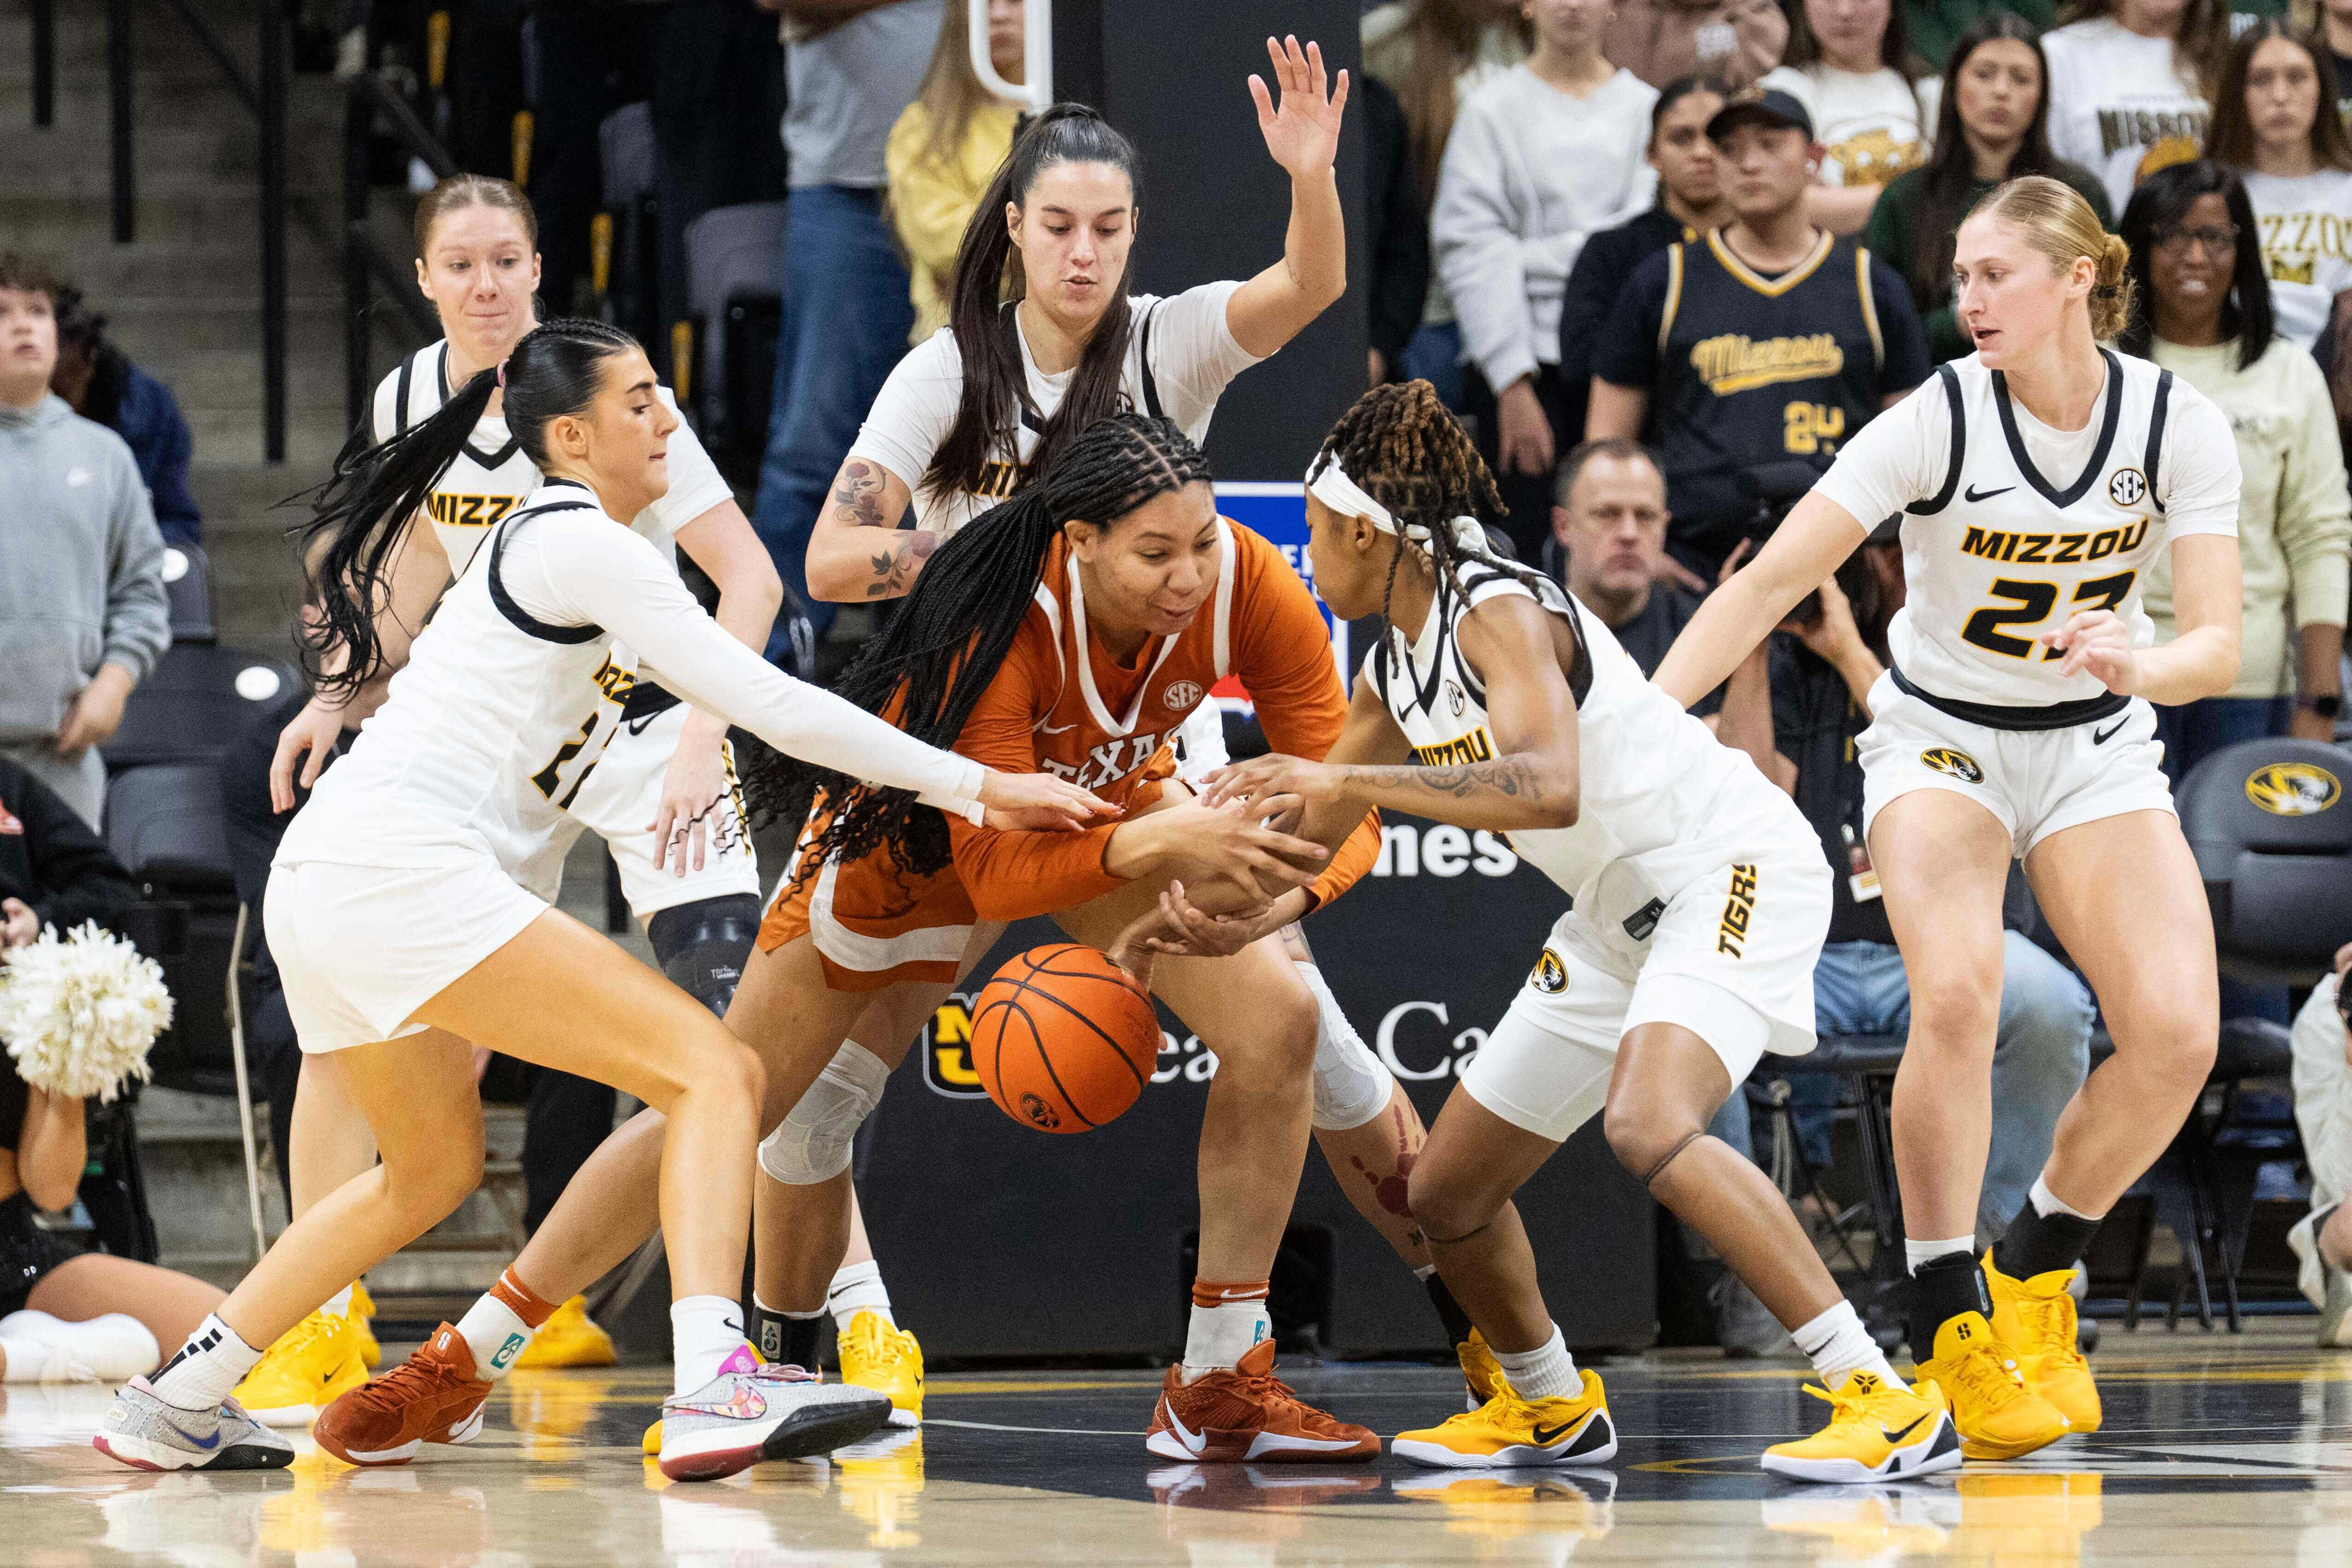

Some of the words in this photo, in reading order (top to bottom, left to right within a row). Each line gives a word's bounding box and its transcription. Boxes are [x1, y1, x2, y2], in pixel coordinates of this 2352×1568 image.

[427, 492, 526, 527] MIZZ
[2110, 470, 2145, 504] SEC
[1959, 514, 2148, 564] MIZZOU
[1166, 681, 1199, 709] SEC
[1041, 733, 1156, 791] TEXA
[1371, 824, 1518, 877] nes
[1376, 1001, 1490, 1080] Ca
